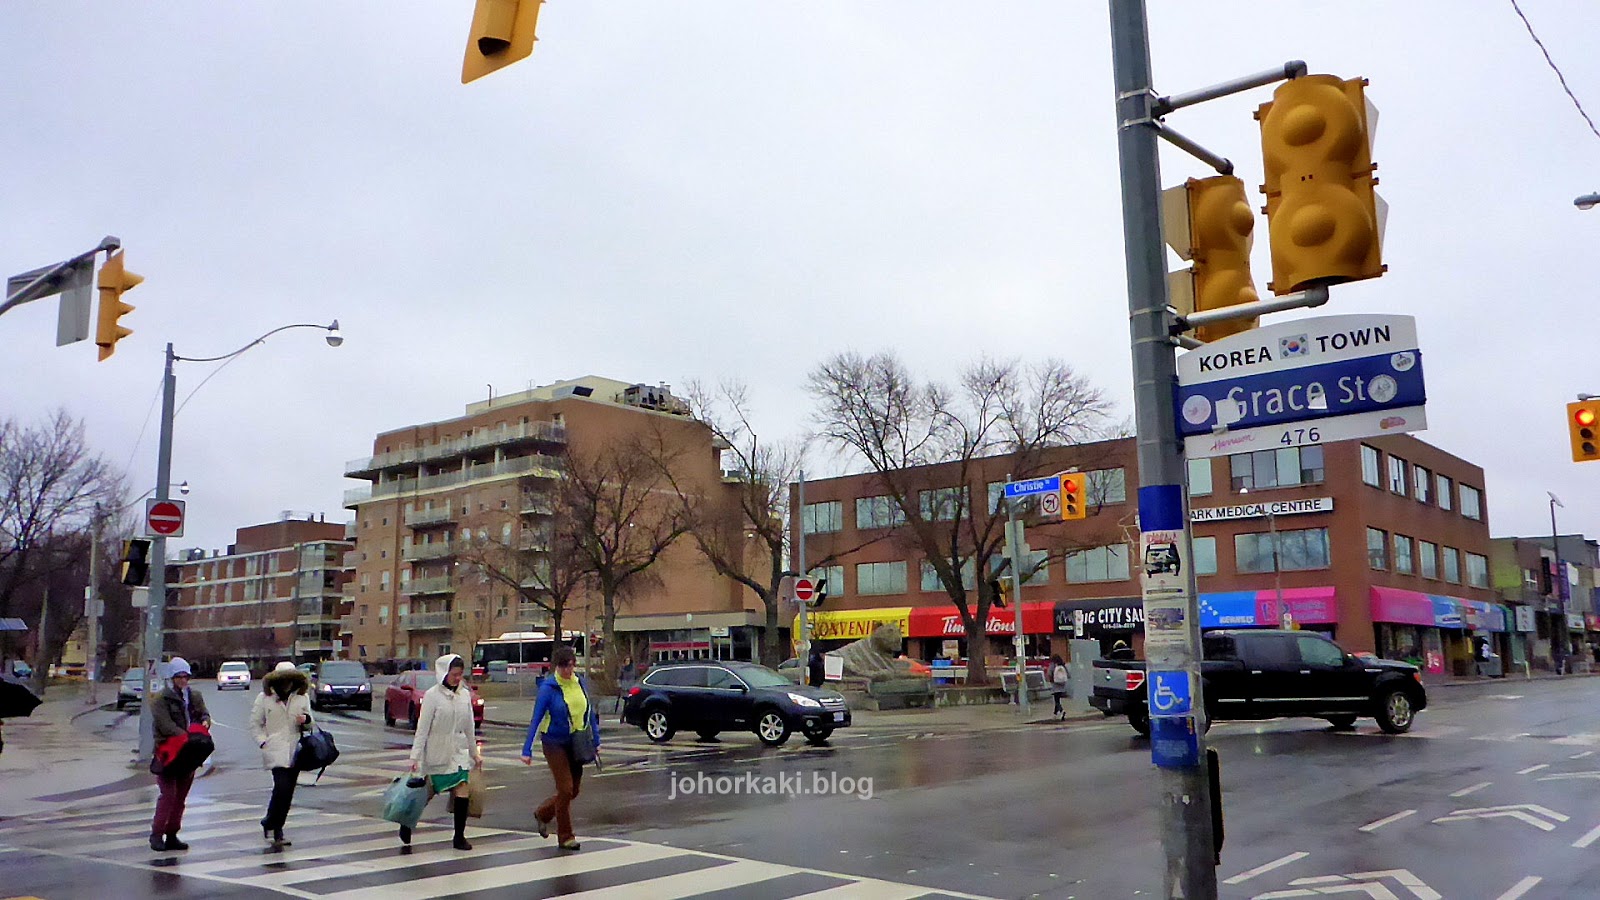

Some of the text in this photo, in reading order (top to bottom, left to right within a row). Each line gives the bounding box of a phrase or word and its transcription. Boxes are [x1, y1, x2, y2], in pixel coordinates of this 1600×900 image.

[1199, 325, 1391, 372] KOREA TOWN
[1338, 375, 1367, 405] St
[1280, 427, 1321, 446] 476
[1013, 481, 1044, 493] Christie
[1216, 504, 1267, 519] MEDICAL
[1271, 499, 1322, 513] CENTRE
[942, 615, 965, 634] Tim
[1098, 607, 1123, 624] CITY
